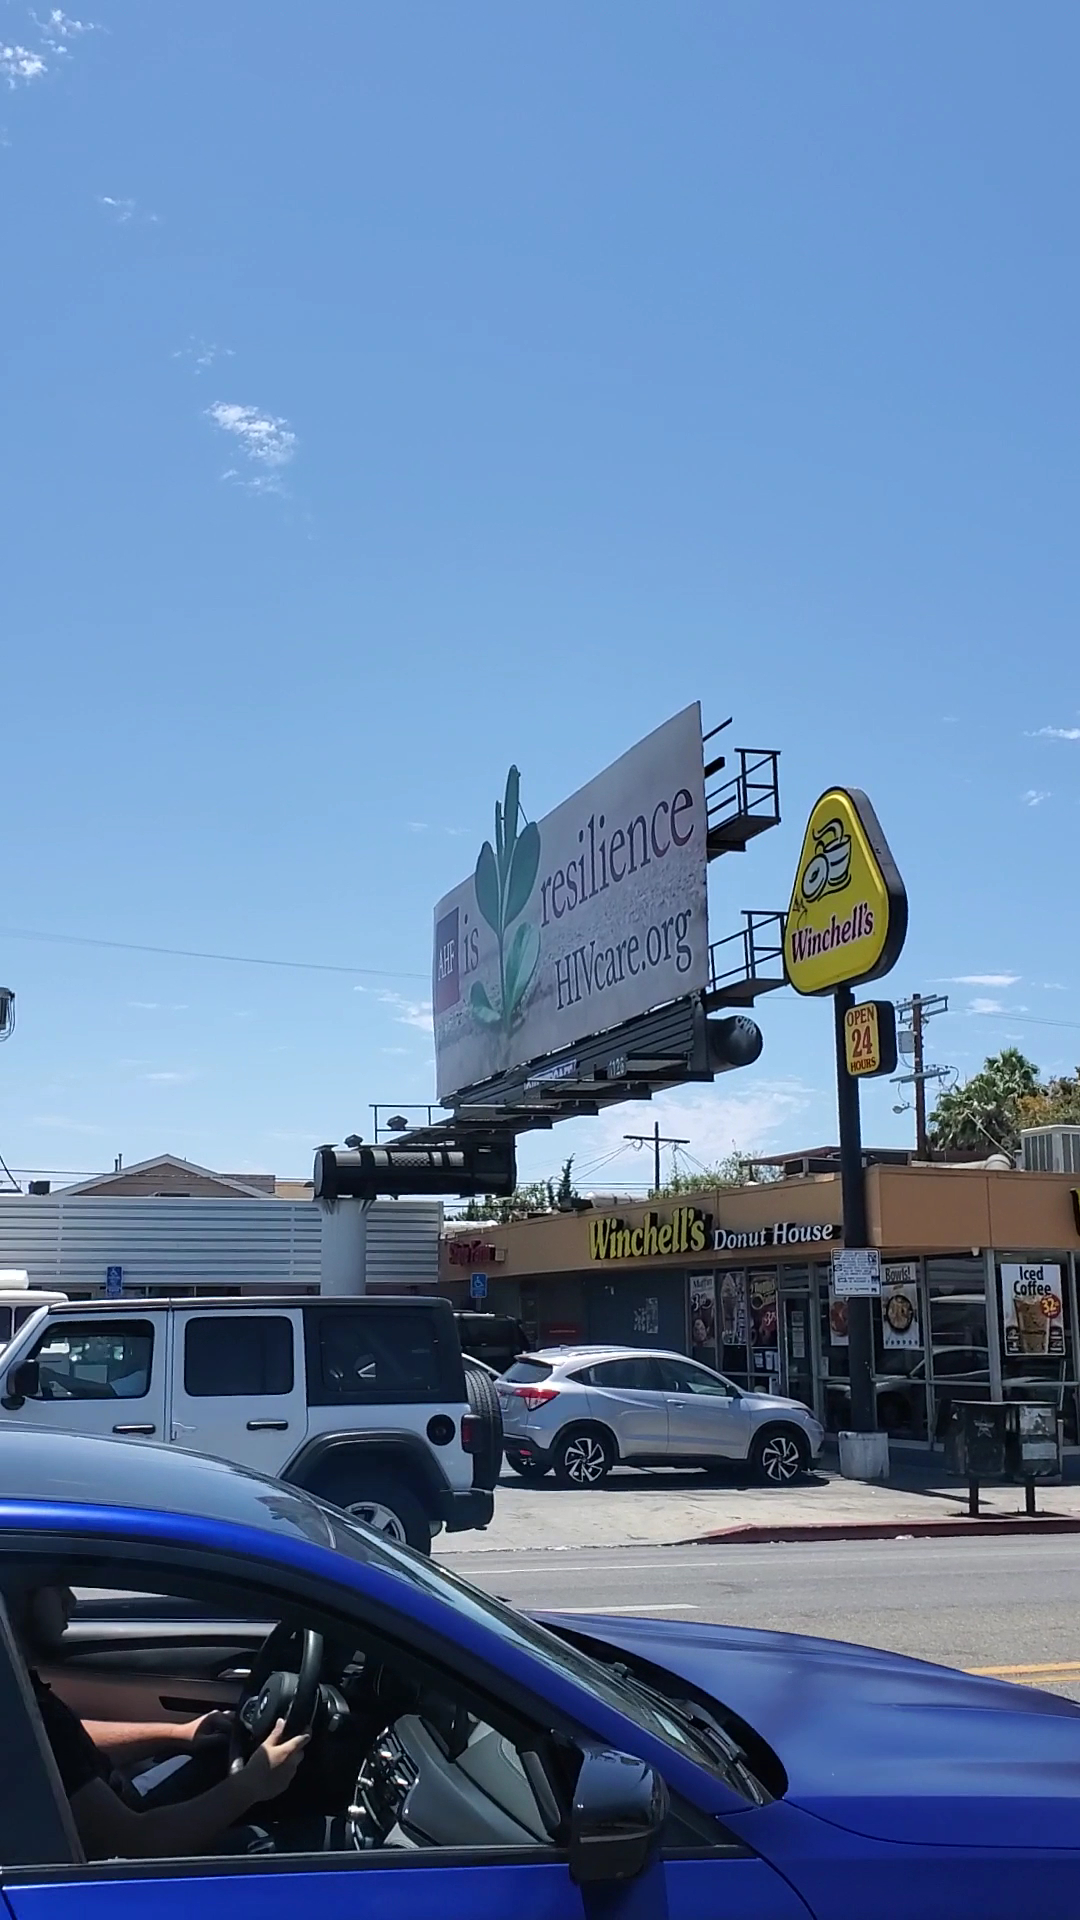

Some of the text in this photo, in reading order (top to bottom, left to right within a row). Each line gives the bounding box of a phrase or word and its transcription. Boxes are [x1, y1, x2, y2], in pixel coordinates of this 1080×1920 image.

[540, 788, 694, 928] resilience
[438, 913, 479, 981] AHF is
[791, 902, 873, 963] Winchell's
[555, 908, 692, 1010] HIVcare.org
[847, 1006, 875, 1027] OPEN
[852, 1025, 873, 1058] 24
[850, 1057, 876, 1072] HOURS
[589, 1207, 833, 1259] Winchell's Donut House
[1013, 1280, 1052, 1296] Coffee
[1019, 1266, 1044, 1281] Iced
